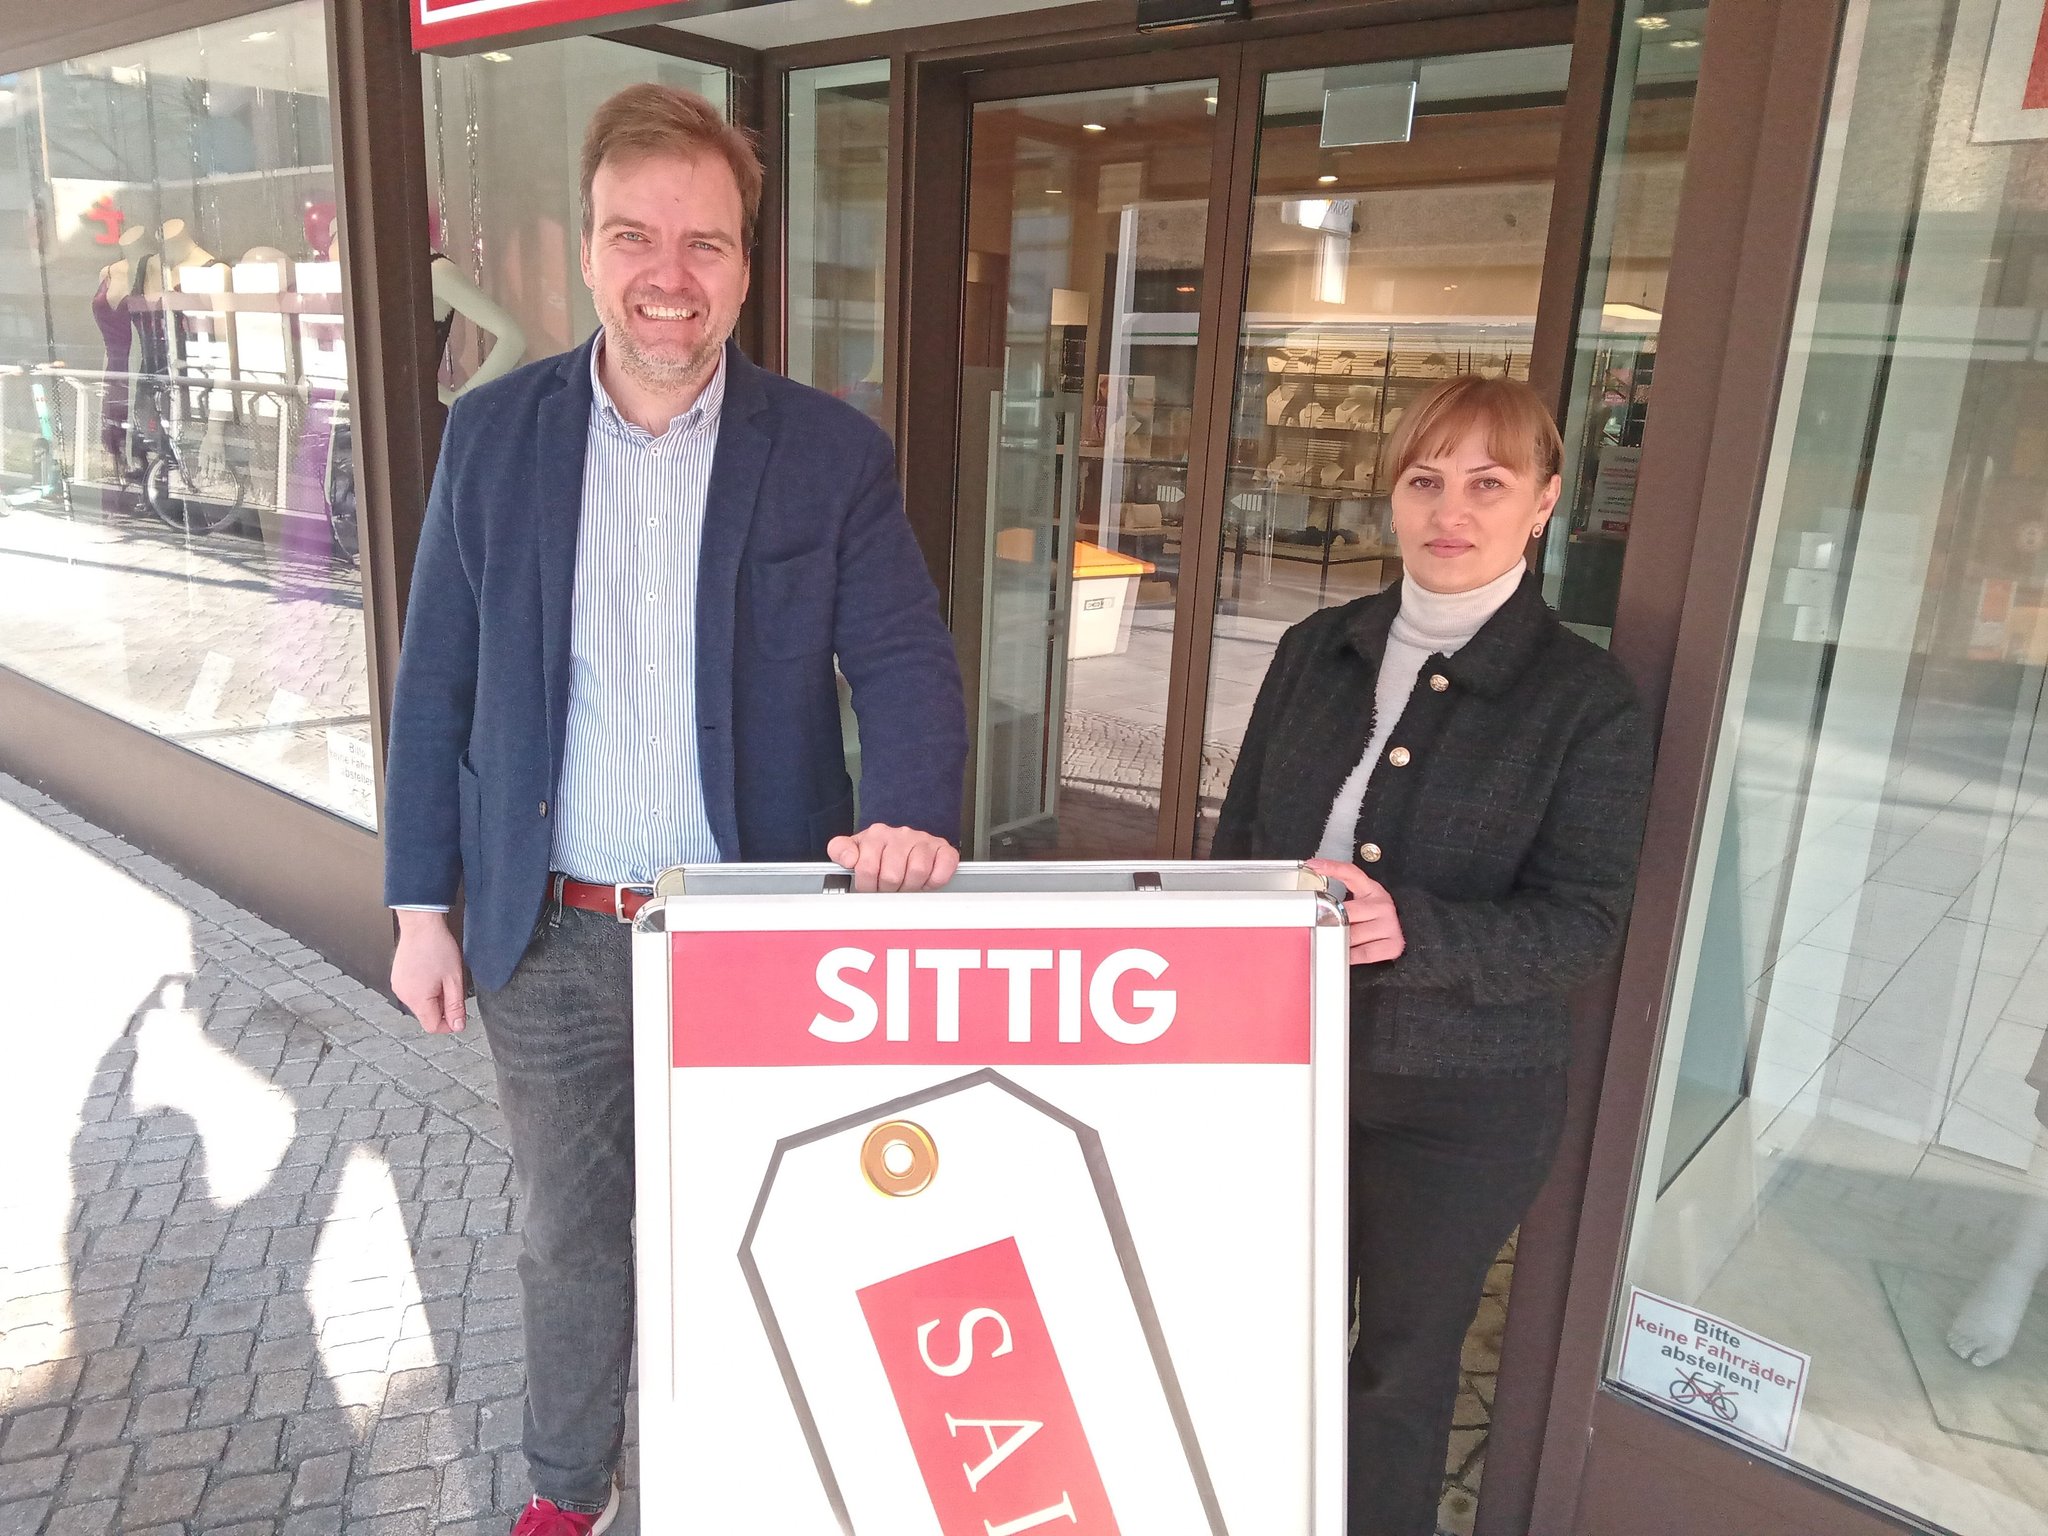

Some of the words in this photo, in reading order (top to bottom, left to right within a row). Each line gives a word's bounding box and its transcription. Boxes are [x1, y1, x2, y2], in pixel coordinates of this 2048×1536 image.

[807, 946, 1177, 1045] SITTIG
[1635, 1313, 1688, 1345] keine
[1695, 1336, 1796, 1389] Fahrräder
[1694, 1318, 1741, 1348] Bitte
[1661, 1344, 1760, 1393] abstellen!
